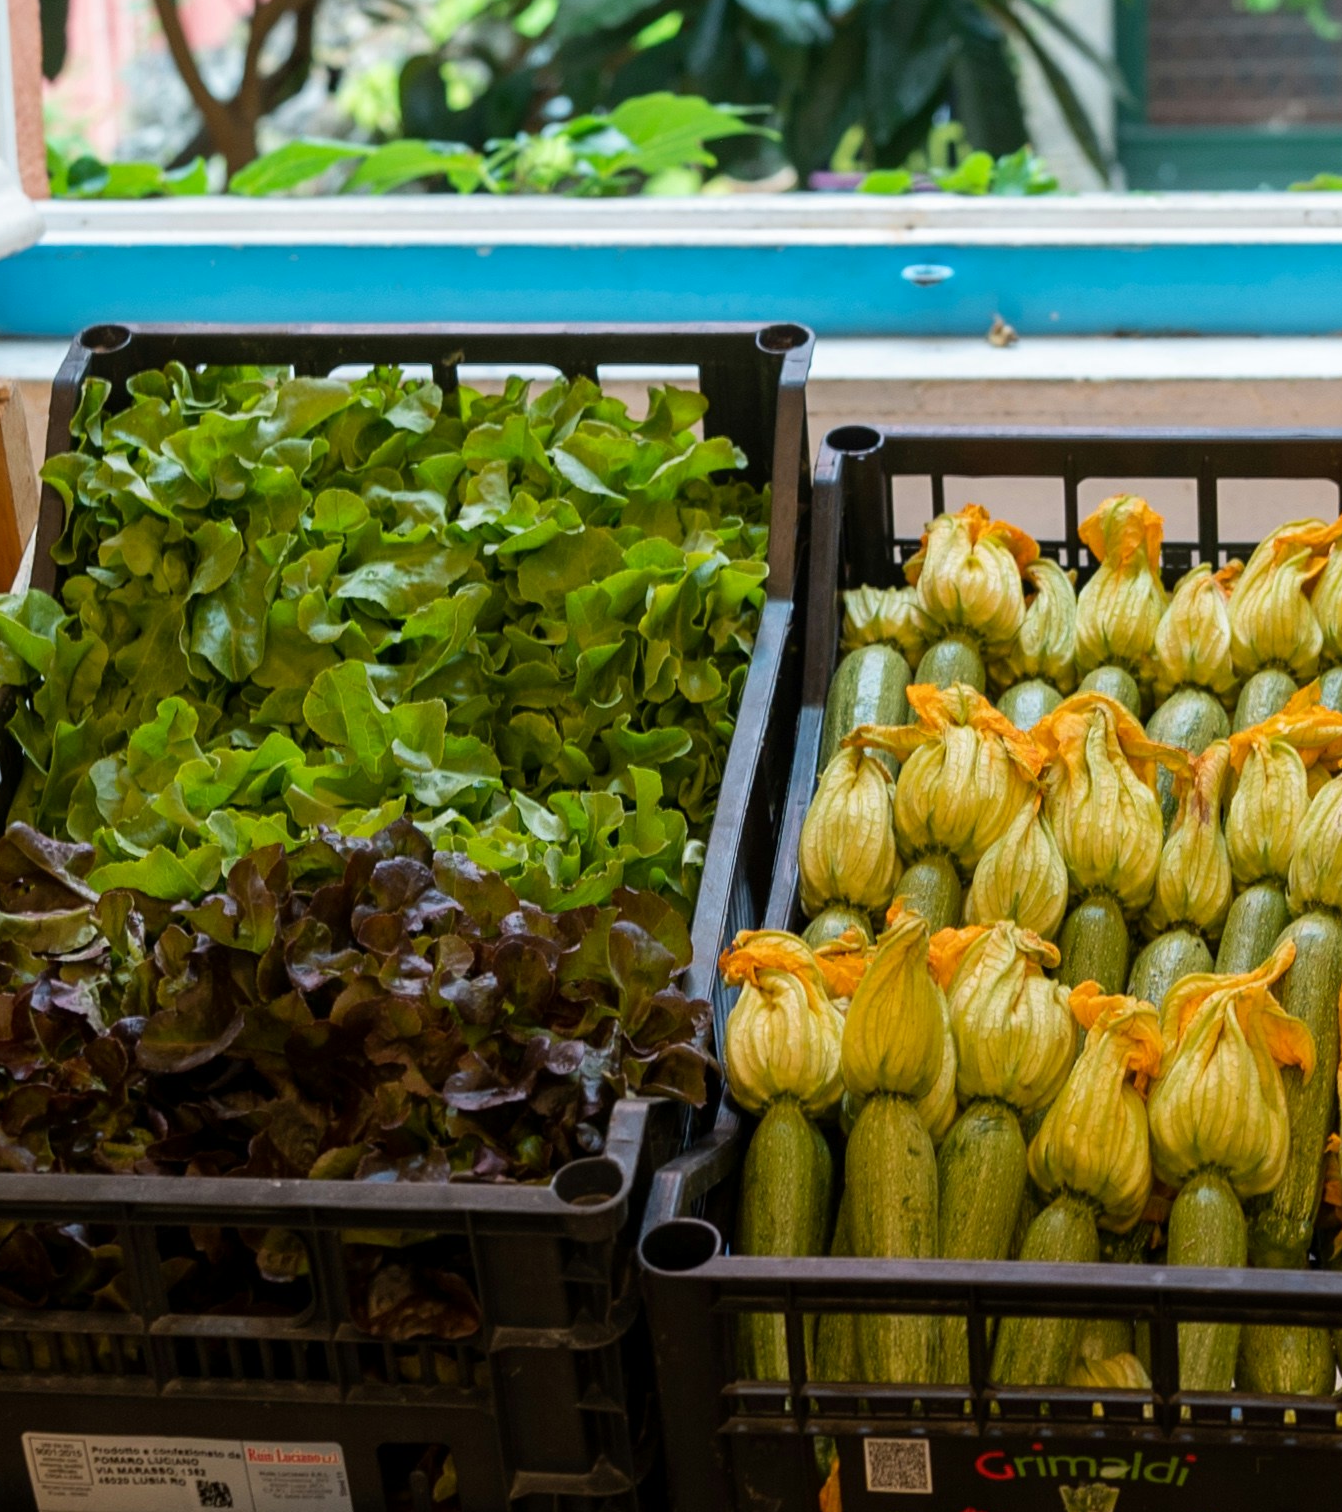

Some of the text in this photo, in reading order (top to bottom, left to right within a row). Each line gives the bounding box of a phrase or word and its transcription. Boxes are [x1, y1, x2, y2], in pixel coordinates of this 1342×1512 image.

[91, 1446, 139, 1456] Prodotto
[152, 1448, 225, 1459] confezionato
[974, 1441, 1197, 1487] Grimaldi
